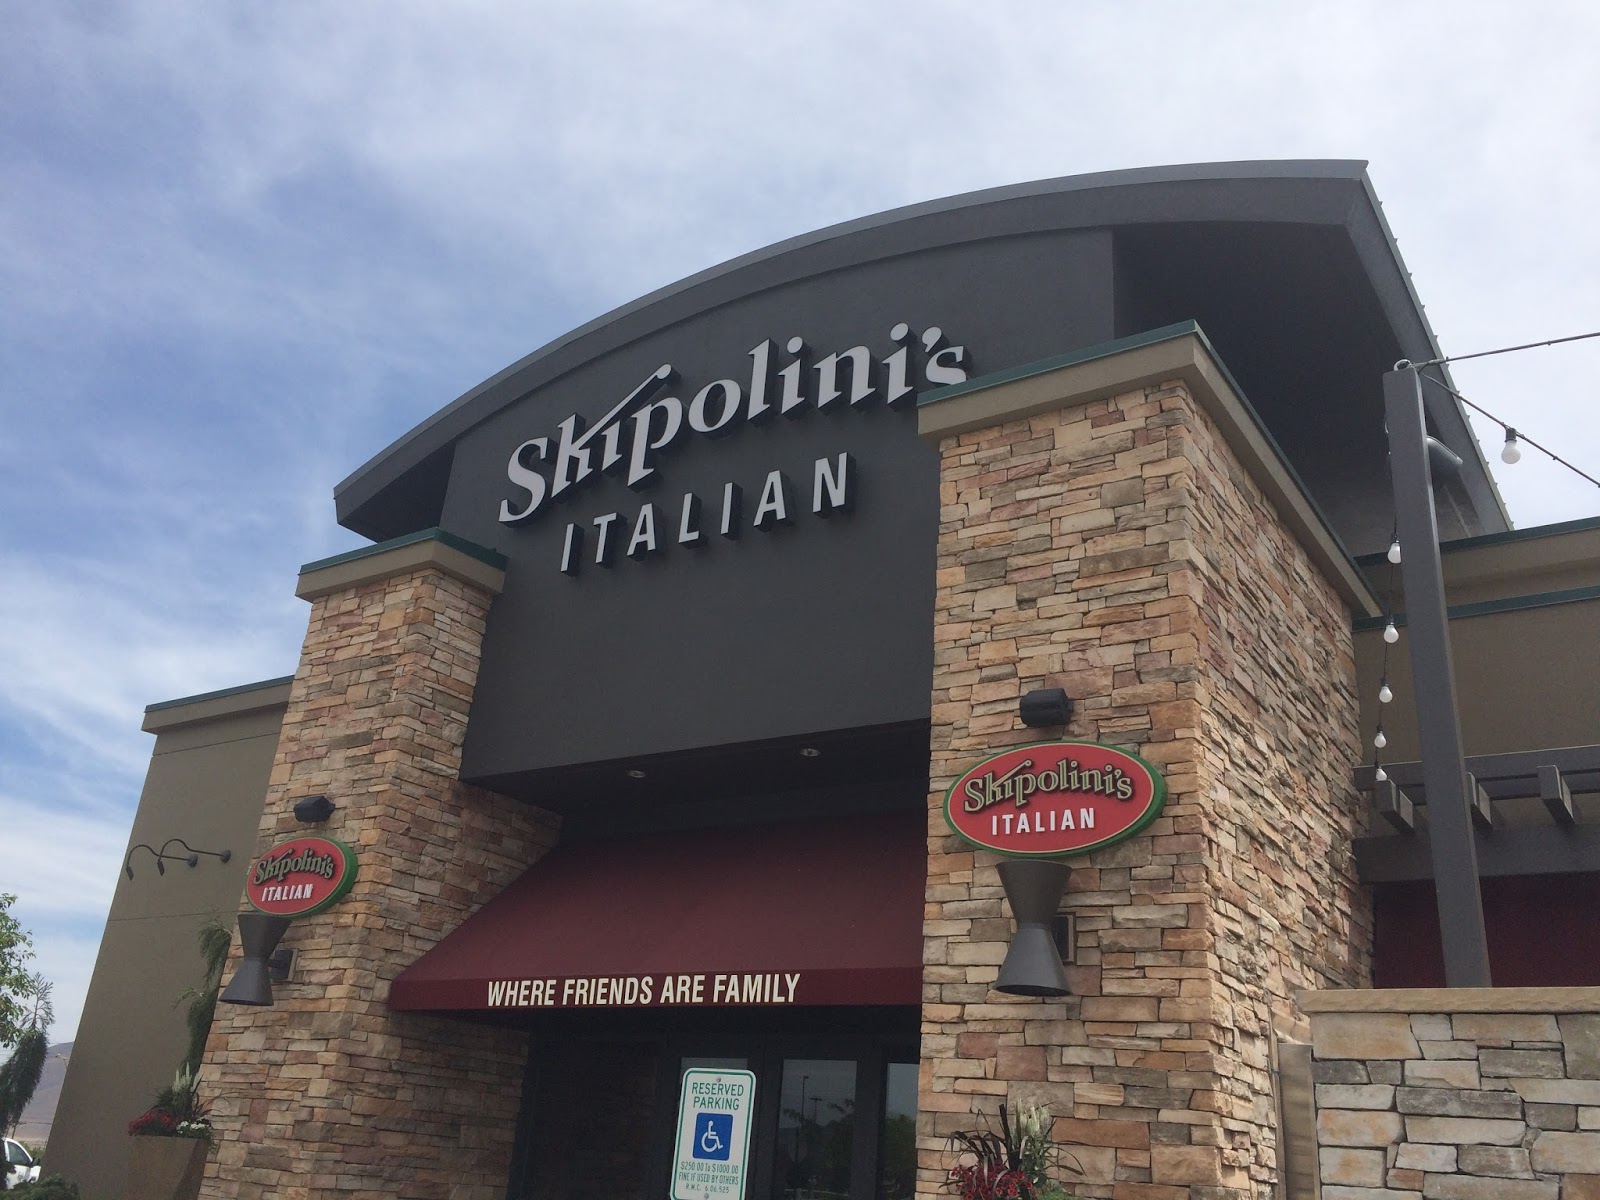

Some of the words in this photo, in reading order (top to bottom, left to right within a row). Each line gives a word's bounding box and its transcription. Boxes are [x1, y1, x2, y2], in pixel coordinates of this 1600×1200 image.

[499, 322, 967, 523] Skipolini's
[560, 451, 849, 573] ITALIAN
[963, 758, 1134, 813] Skipolini's
[991, 807, 1095, 836] ITALIAN
[253, 847, 335, 885] Skipolini's
[261, 883, 314, 902] ITALIAN
[487, 979, 557, 1007] WHERE
[562, 976, 653, 1005] FRIENDS
[659, 974, 705, 1004] ARE
[712, 973, 800, 1003] FAMILY
[691, 1082, 744, 1097] RESERVED
[693, 1096, 740, 1111] PARKING
[678, 1171, 690, 1181] FINE
[697, 1173, 710, 1183] USED
[711, 1174, 719, 1183] BY
[719, 1175, 739, 1185] OTHERS
